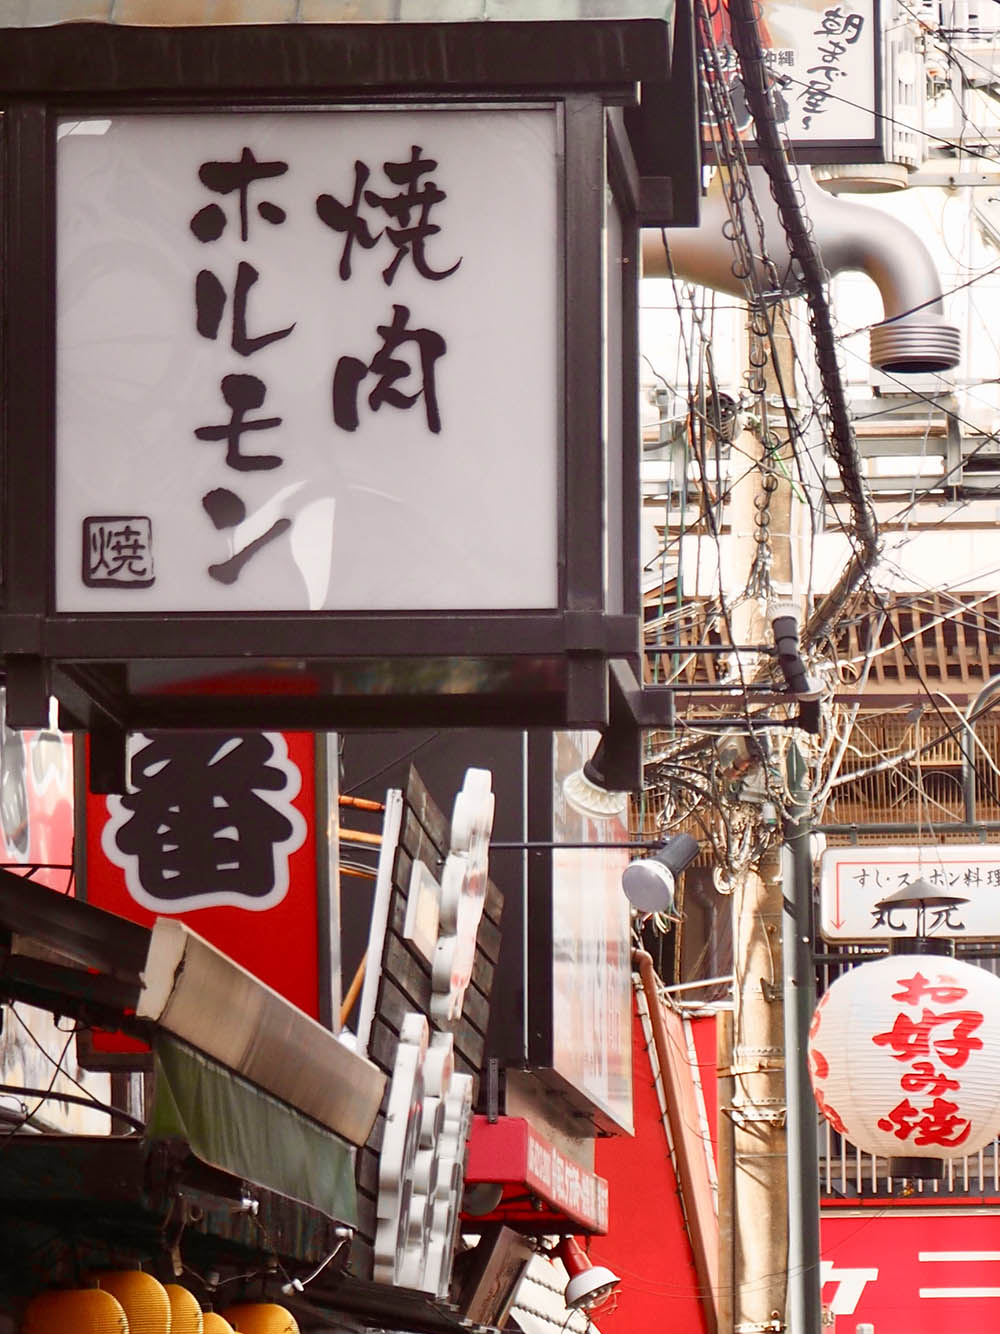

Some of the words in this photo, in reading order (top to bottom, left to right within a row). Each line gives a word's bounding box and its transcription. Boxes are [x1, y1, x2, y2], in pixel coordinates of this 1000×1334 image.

[190, 146, 297, 586] ホルモン
[316, 145, 464, 435] 焼肉
[86, 521, 150, 582] 焼
[872, 971, 984, 1148] お好み焼
